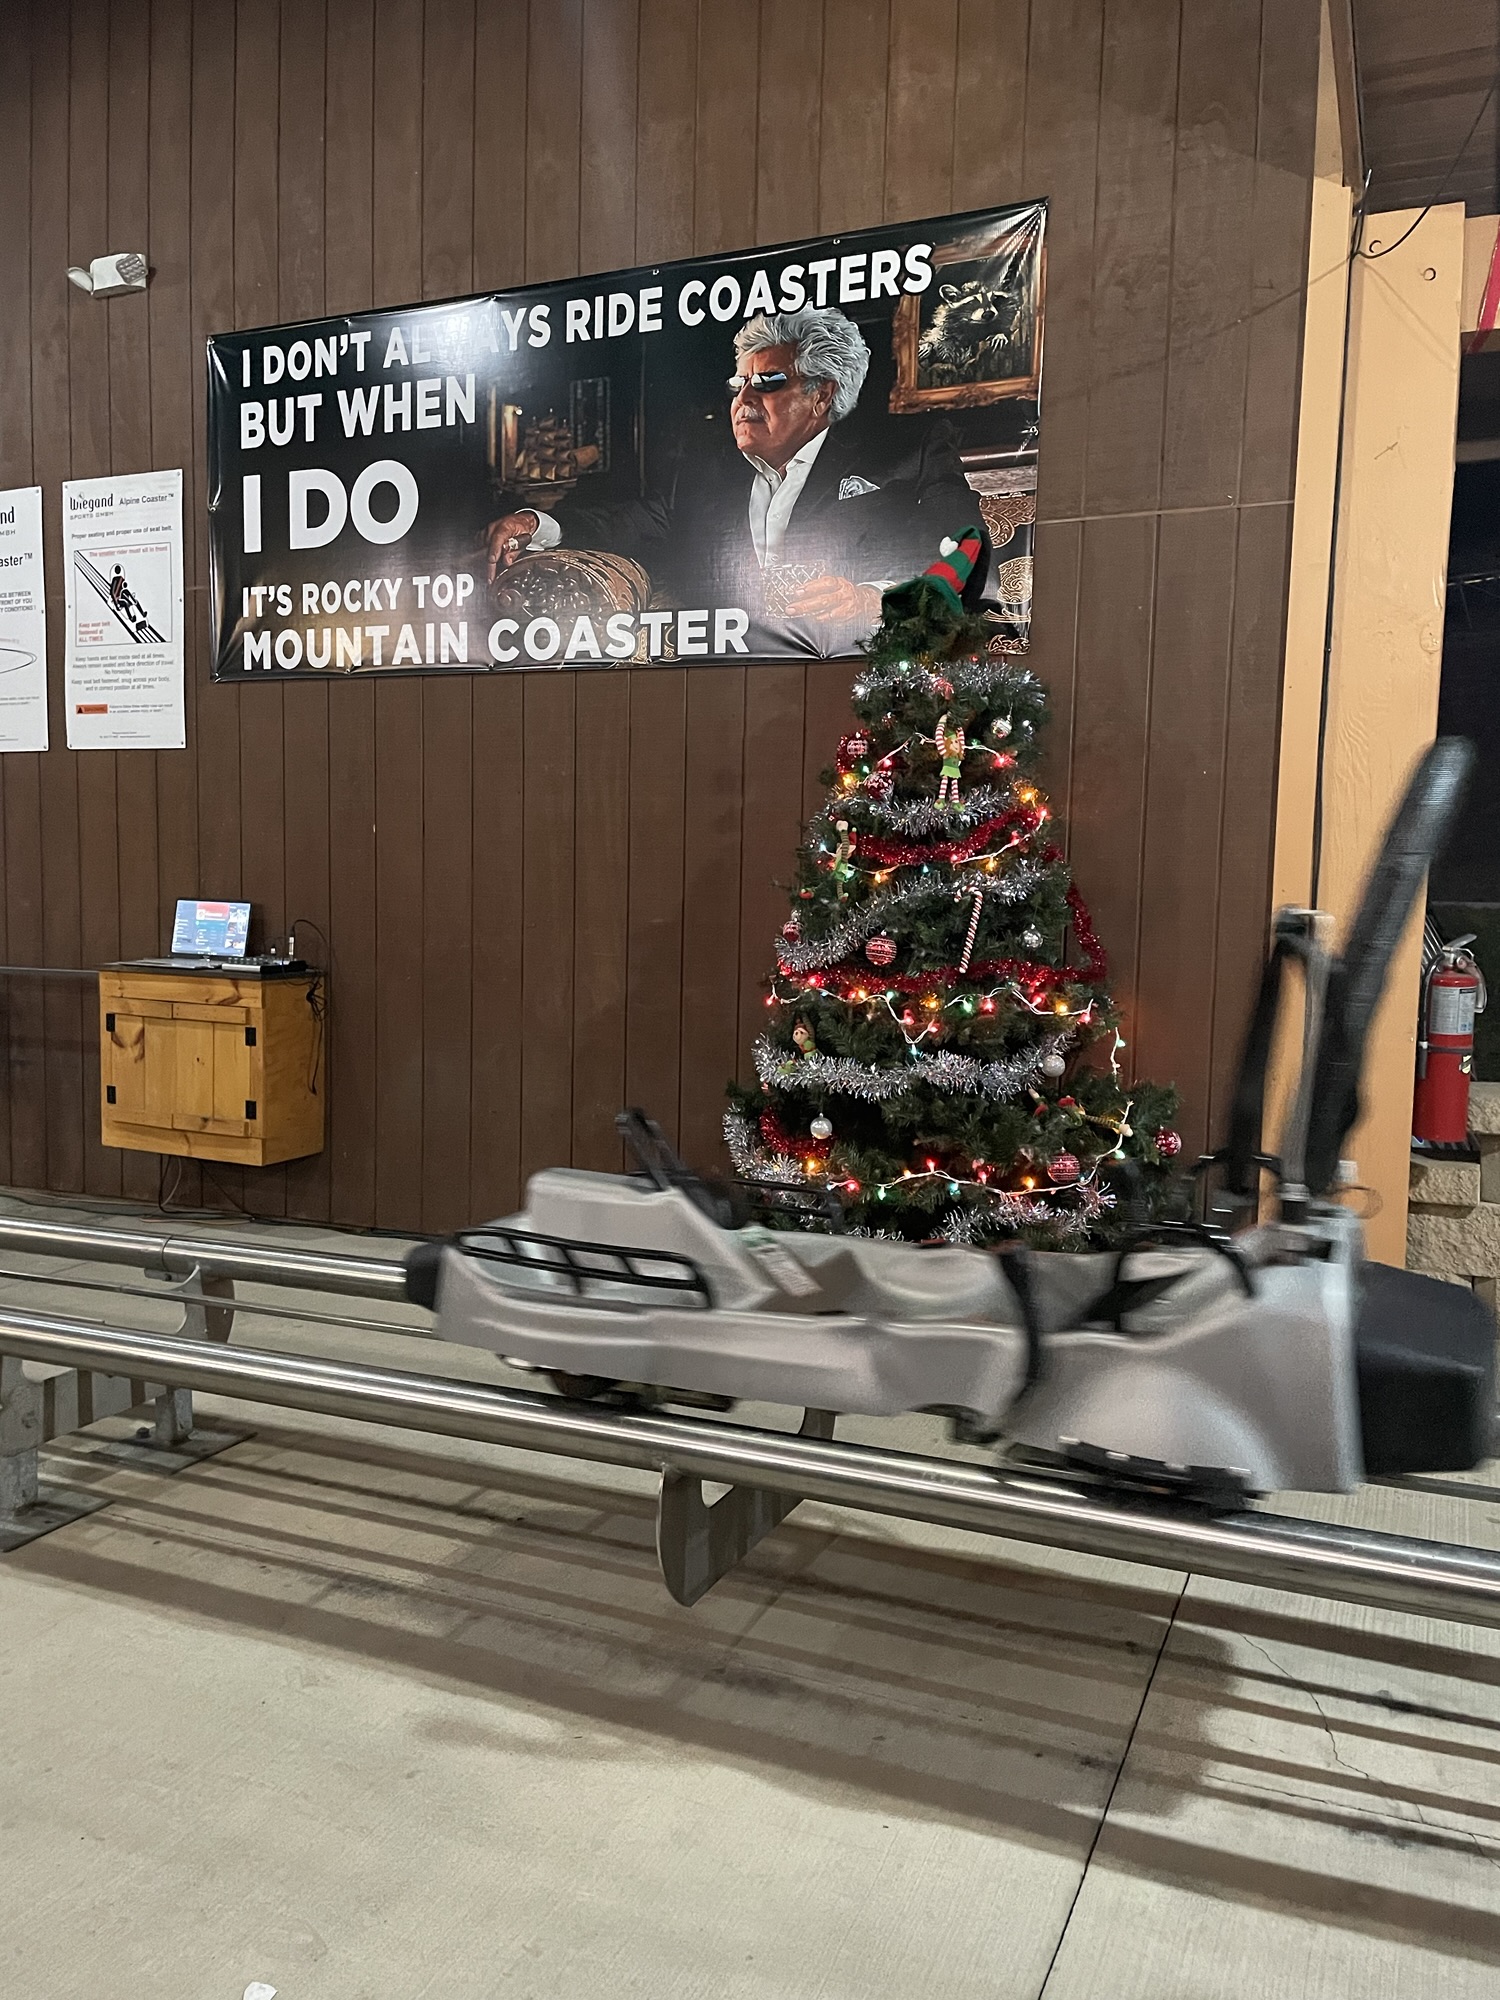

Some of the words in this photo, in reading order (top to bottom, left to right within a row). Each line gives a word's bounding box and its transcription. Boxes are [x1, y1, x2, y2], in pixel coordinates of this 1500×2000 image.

[242, 349, 251, 387] I
[263, 331, 371, 384] DON'T
[383, 304, 551, 368] ALAYS
[566, 287, 663, 343] RIDE
[678, 244, 934, 327] COASTERS
[240, 393, 323, 449] BUT
[337, 373, 476, 438] WHEN
[70, 493, 114, 513] Wiegand
[119, 497, 140, 506] Alpine
[70, 512, 94, 520] SPORTS
[243, 474, 262, 553] I
[289, 459, 419, 550] DO
[116, 528, 132, 536] proper
[4, 604, 33, 613] CONDITIONS
[8, 590, 31, 598] BETWEEN
[242, 584, 292, 617] IT'S
[302, 578, 403, 615] ROCKY
[412, 573, 475, 608] TOP
[243, 621, 468, 670] MOUNTAIN
[488, 607, 750, 663] COASTER
